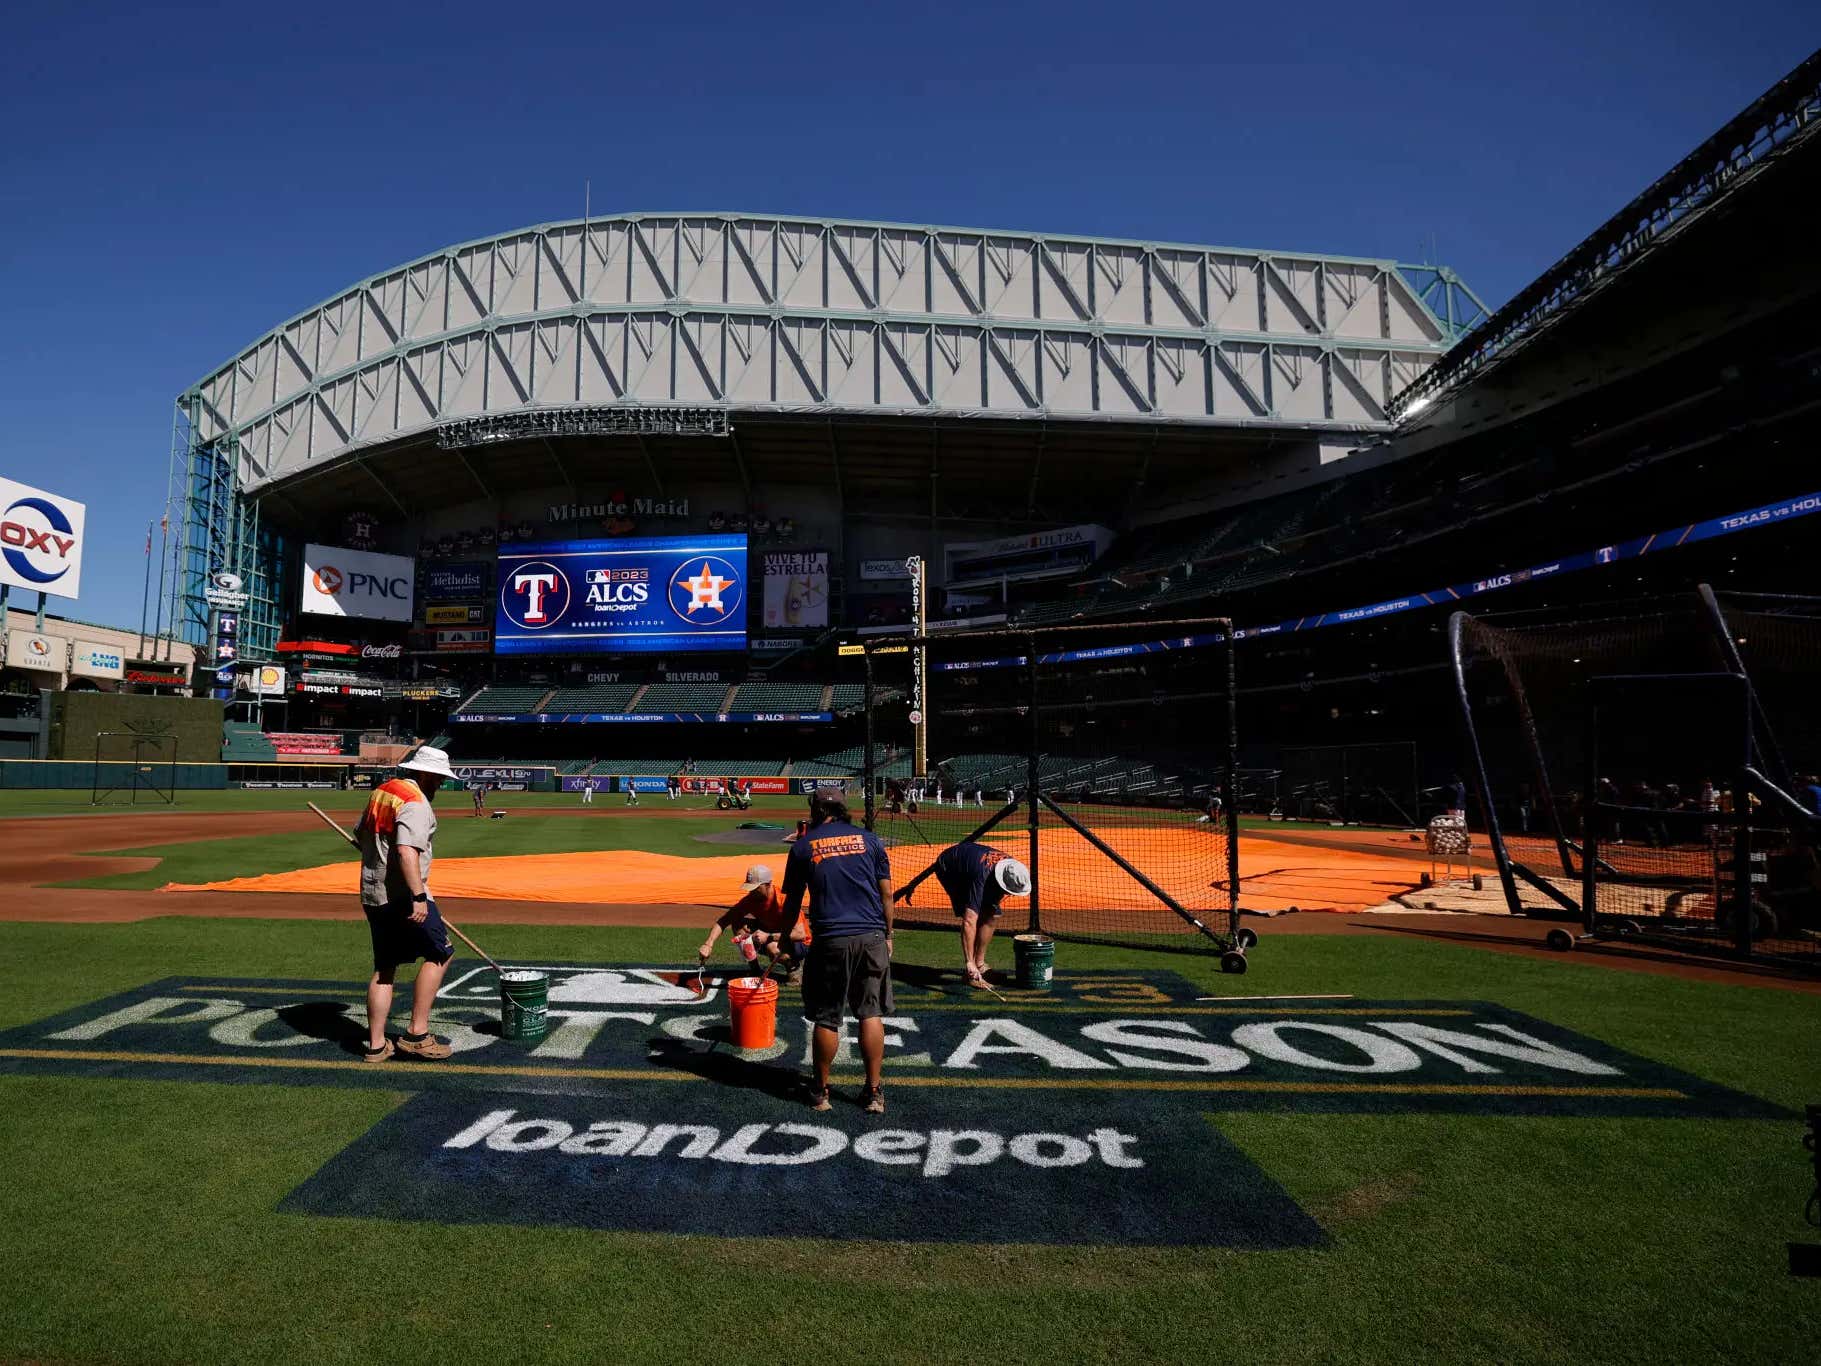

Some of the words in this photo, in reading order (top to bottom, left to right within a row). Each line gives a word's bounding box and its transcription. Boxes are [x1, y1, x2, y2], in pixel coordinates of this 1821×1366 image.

[550, 500, 628, 521] Minute
[634, 498, 689, 517] Maid
[1720, 510, 1771, 529] TEXAS
[1773, 507, 1790, 516] vs
[0, 521, 74, 558] OXY
[766, 553, 797, 564] VIVE
[801, 552, 817, 563] TU
[611, 570, 648, 580] 2023
[763, 563, 824, 576] ESTRELLA
[347, 572, 408, 600] PNC
[1487, 575, 1511, 591] ALCS
[514, 573, 558, 623] T
[586, 583, 648, 603] ALCS
[594, 602, 637, 612] loanDepot
[1338, 608, 1365, 620] TEXAS
[1373, 600, 1410, 615] HOUSTON
[587, 673, 620, 682] CHEVY
[665, 672, 719, 682] SILVERADO
[304, 684, 338, 694] impact
[349, 687, 382, 697] impact
[442, 1108, 1146, 1179] loanDepot
